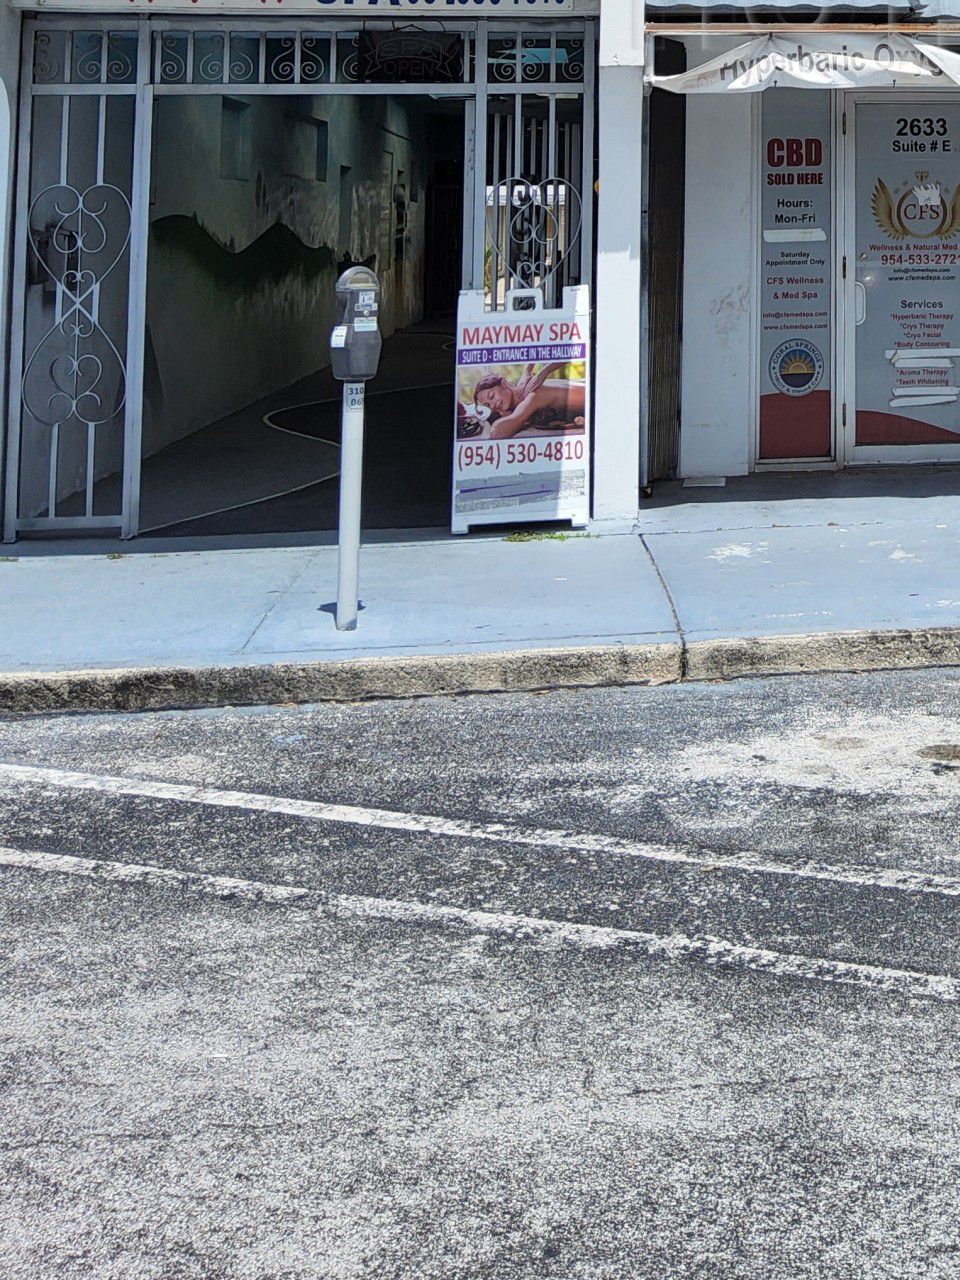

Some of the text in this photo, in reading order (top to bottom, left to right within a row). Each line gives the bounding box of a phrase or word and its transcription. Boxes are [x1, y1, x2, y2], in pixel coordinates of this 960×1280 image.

[384, 61, 434, 76] OPEN
[720, 46, 864, 85] Hyperbaric
[896, 117, 948, 136] 2633
[892, 140, 951, 152] Suite # E
[767, 138, 822, 167] CBD
[767, 173, 823, 185] SOLD HERE
[777, 199, 813, 208] Hours:
[903, 203, 940, 220] CFS
[775, 213, 816, 223] Mon-Fri
[765, 258, 825, 267] Appointment Only
[767, 277, 784, 285] CFS
[773, 291, 818, 300] & Med Spa
[900, 300, 943, 309] Services
[919, 322, 944, 330] Therapy
[463, 322, 581, 346] MAYMAY SPA
[462, 350, 481, 363] SUITE
[482, 350, 488, 360] D
[493, 348, 528, 361] ENTRANCE
[529, 348, 536, 359] IN
[538, 347, 550, 359] THE
[552, 345, 582, 358] HALLWAY
[773, 341, 821, 364] CORAL SPRINGS
[917, 378, 949, 386] Whitening
[458, 440, 584, 471] (954) 530-4810
